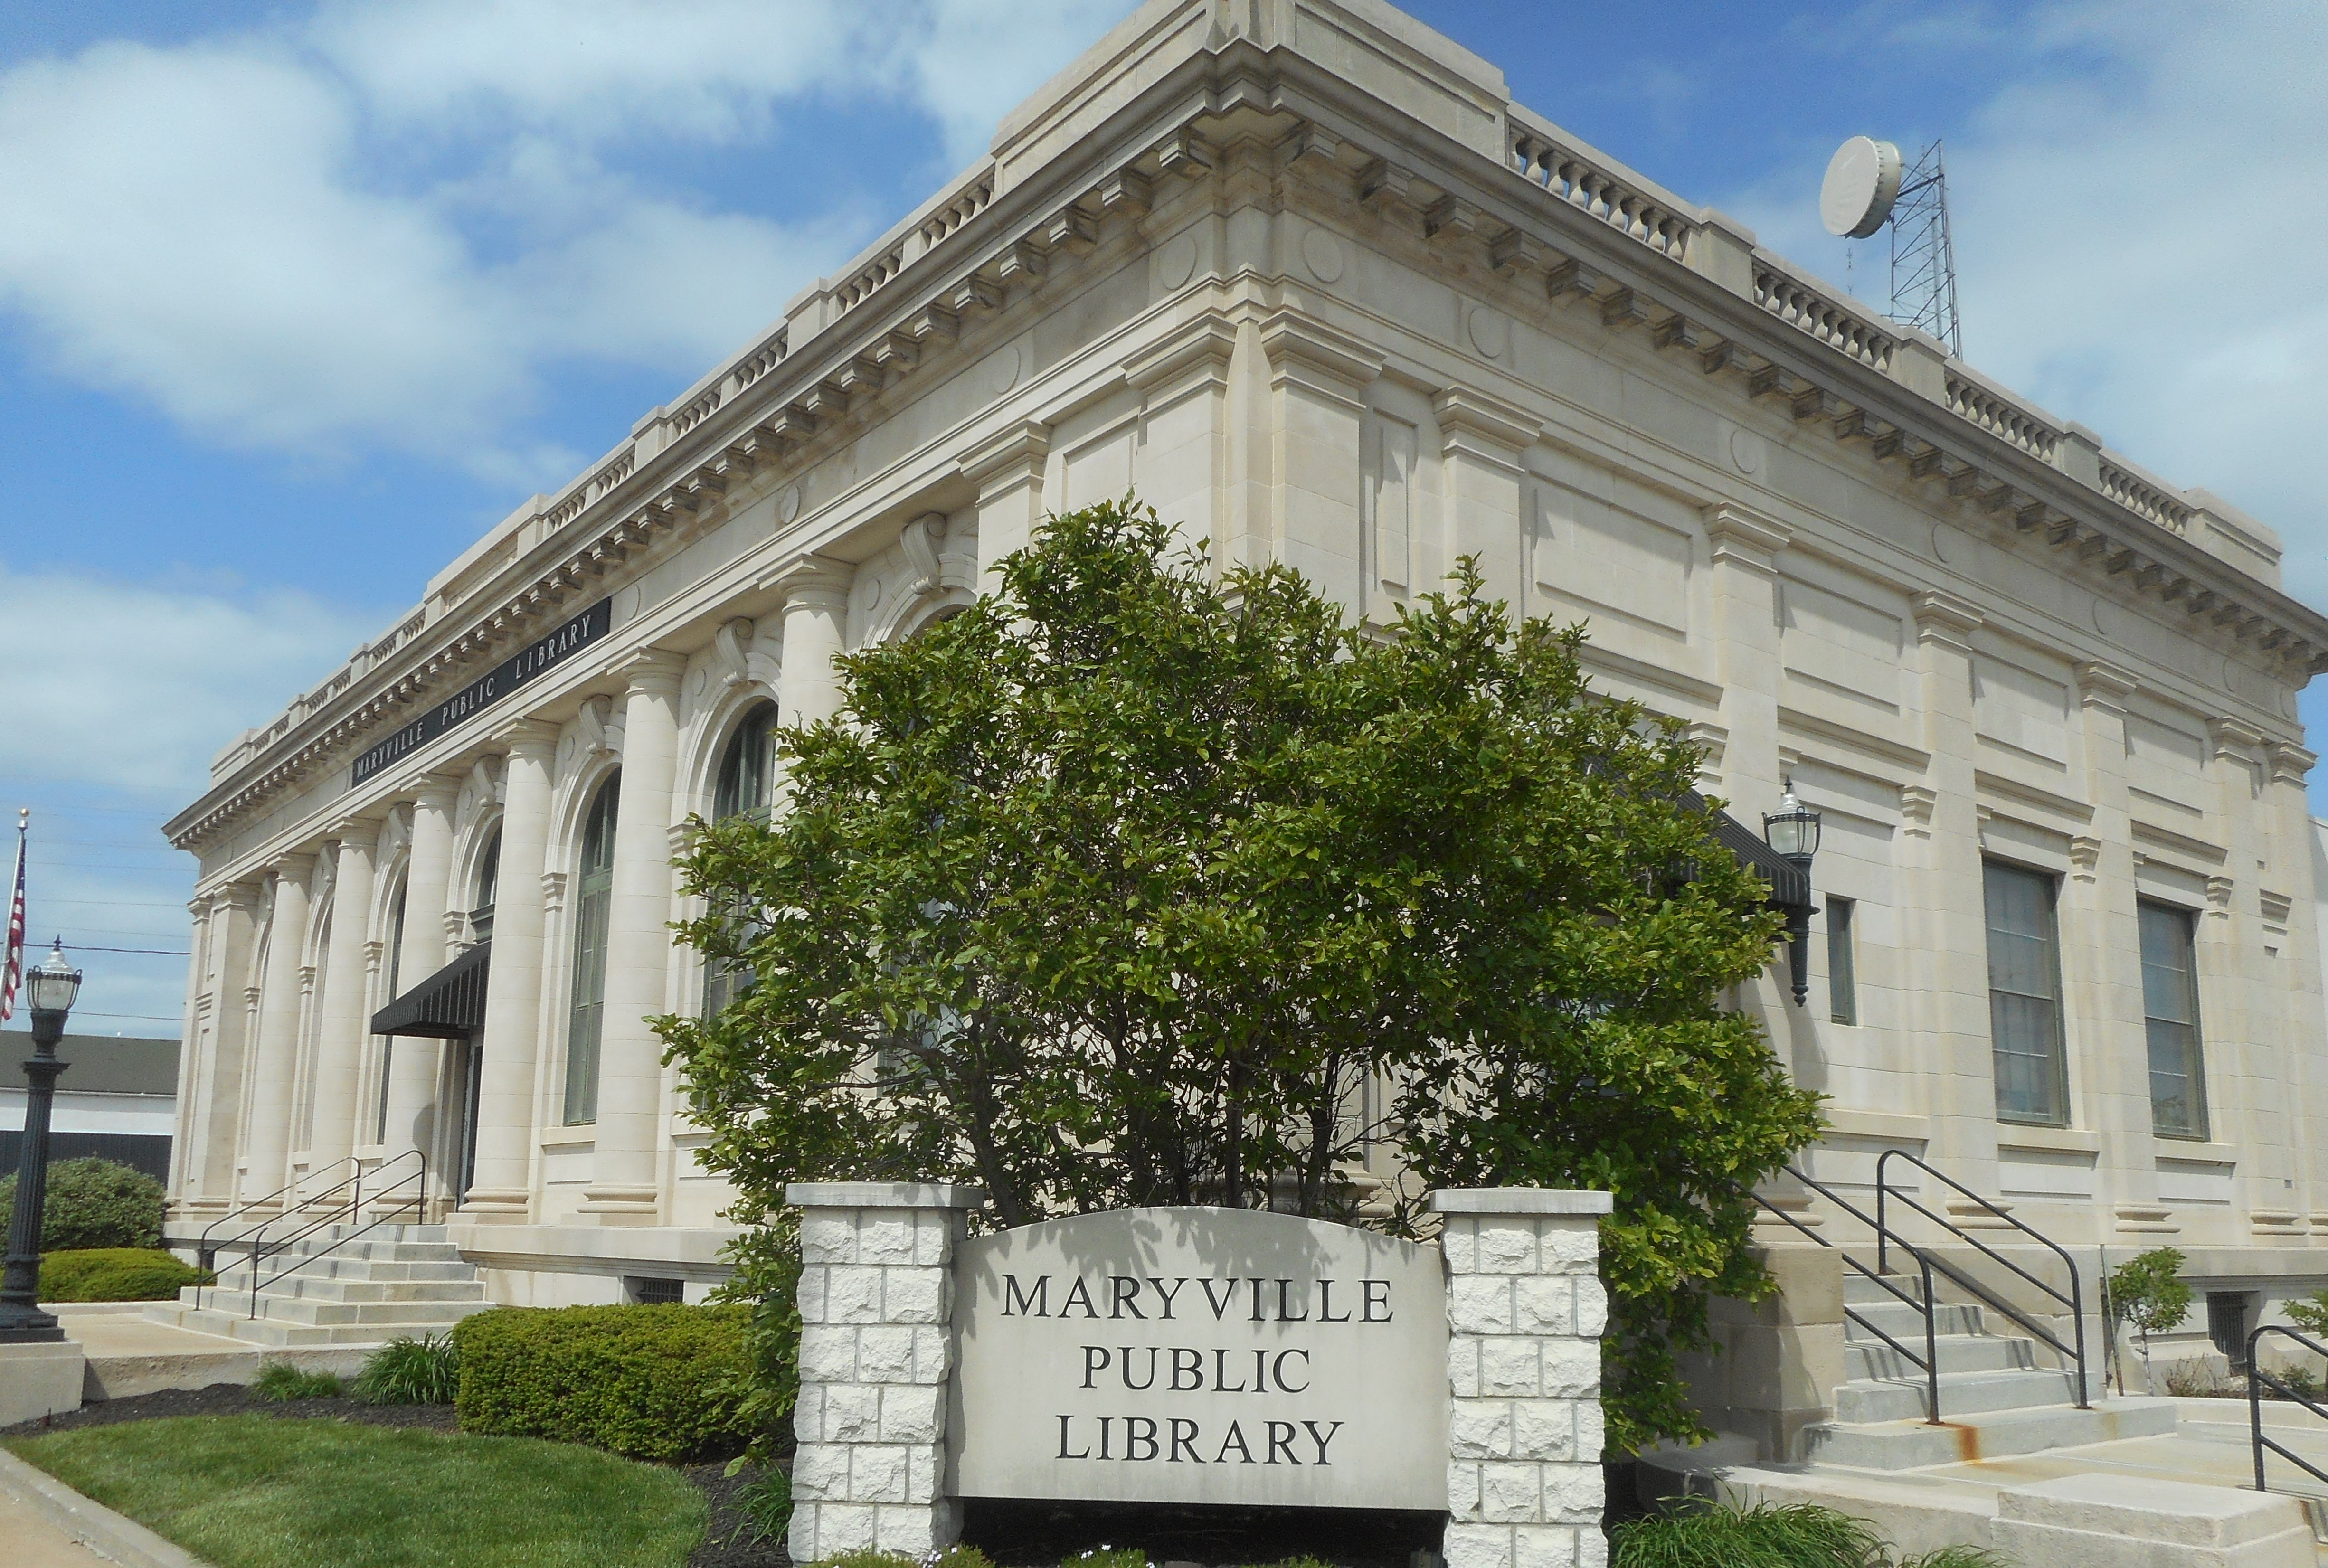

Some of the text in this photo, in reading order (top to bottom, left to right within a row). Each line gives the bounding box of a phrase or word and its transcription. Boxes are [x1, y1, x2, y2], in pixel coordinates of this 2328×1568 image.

[357, 614, 591, 778] MARYVILLE PUBLIC LIBRARY
[1001, 1274, 1395, 1323] MARYVILLE
[1079, 1345, 1311, 1393] PUBLIC
[1055, 1415, 1345, 1465] LIBRARY
